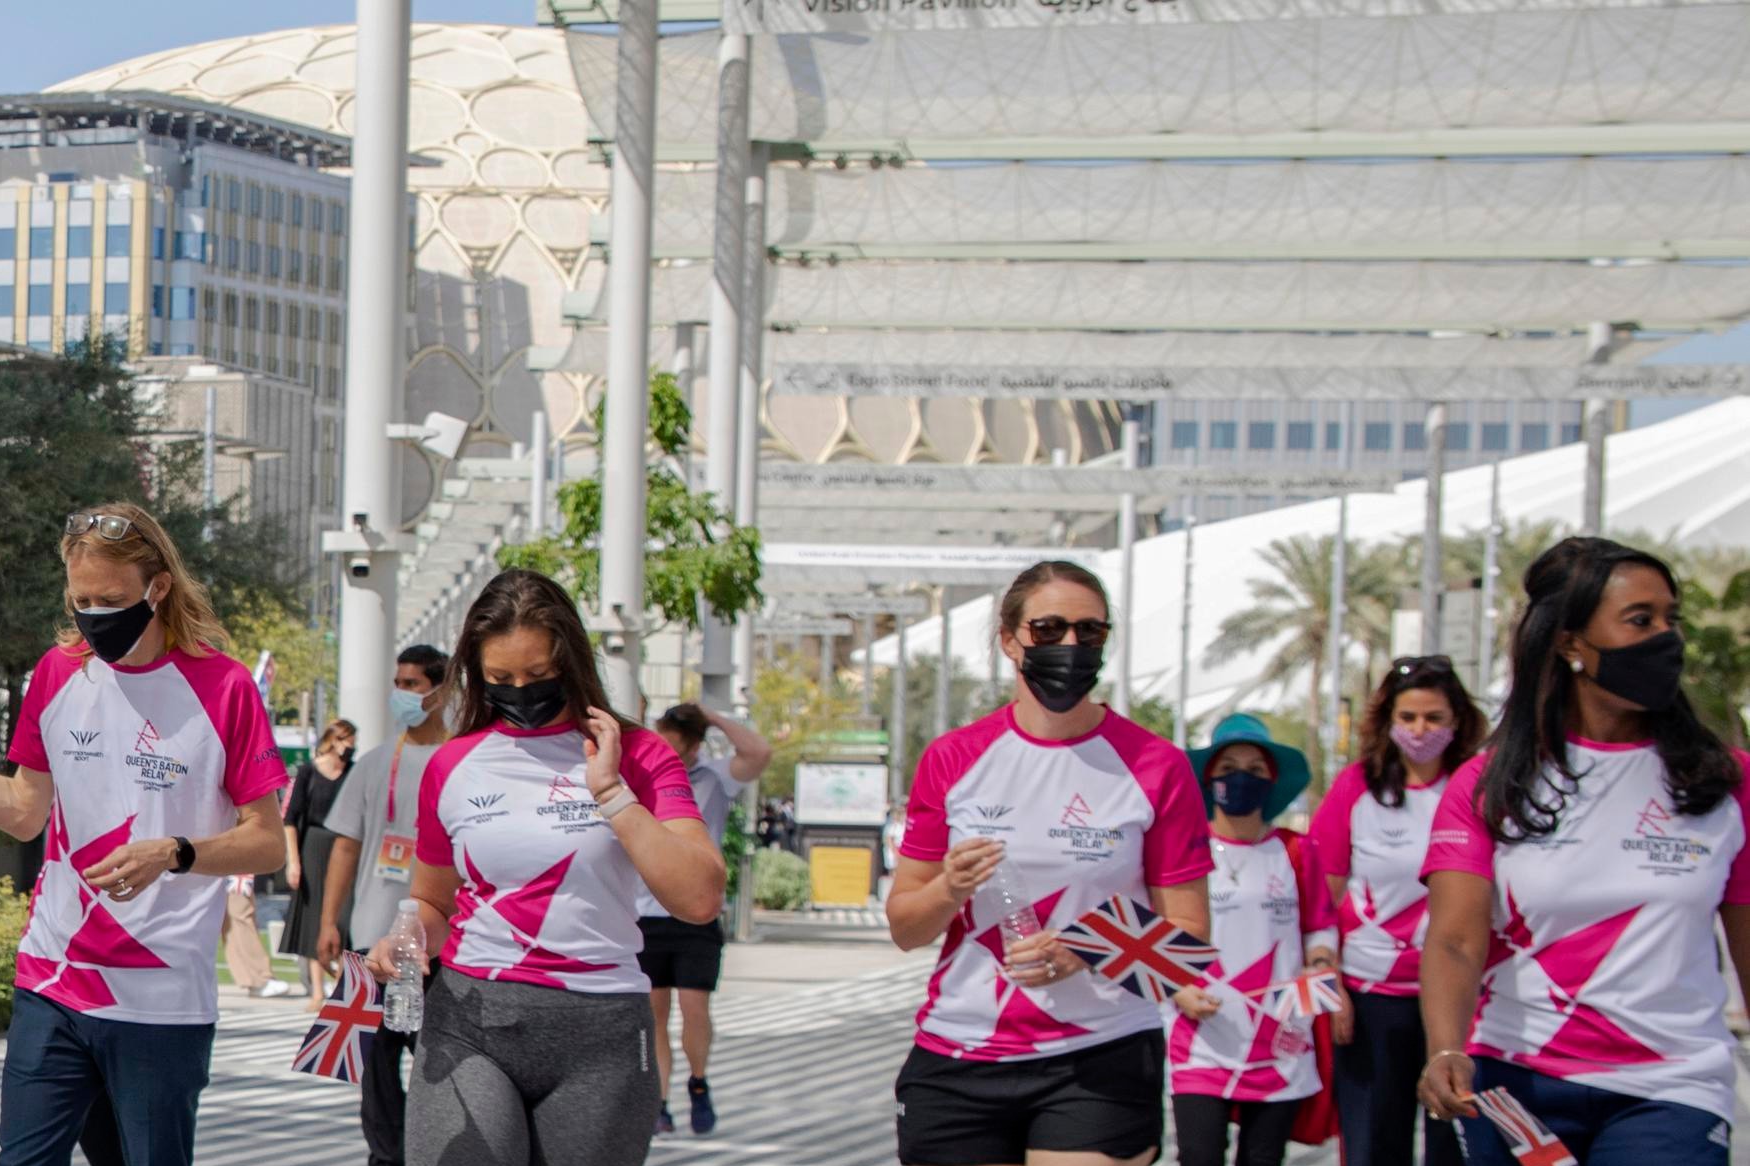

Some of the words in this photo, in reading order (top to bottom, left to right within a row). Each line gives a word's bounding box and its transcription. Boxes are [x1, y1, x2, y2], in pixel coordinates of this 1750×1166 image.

[125, 755, 158, 769] QUEEN'S
[159, 761, 189, 775] BATON
[141, 768, 166, 780] RELAY
[559, 812, 590, 822] RELAY
